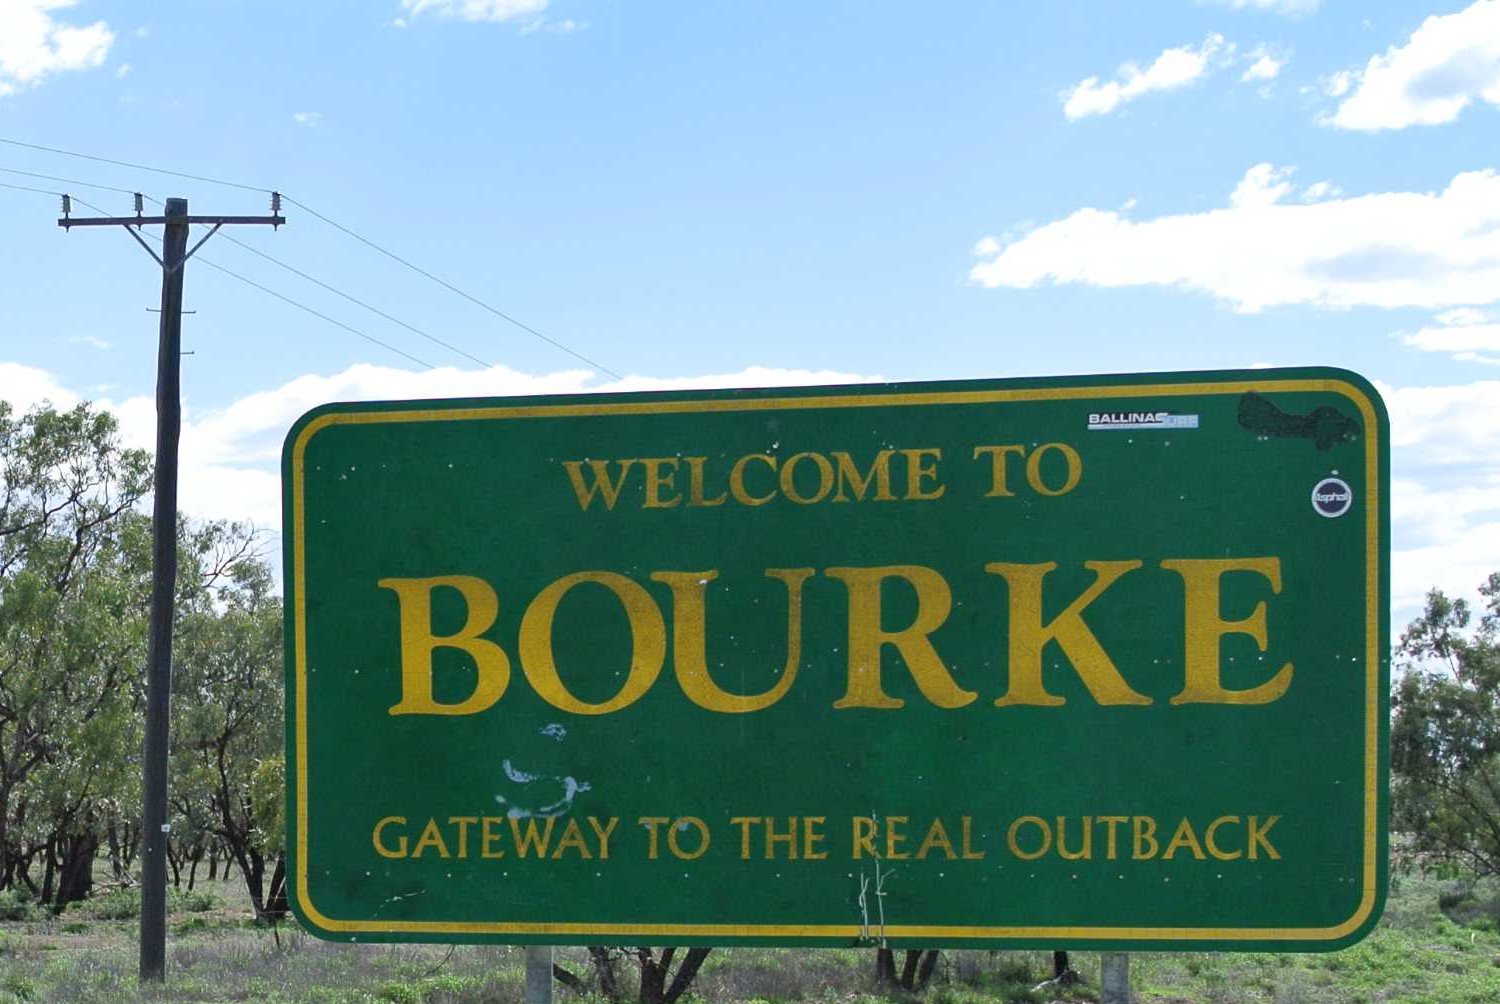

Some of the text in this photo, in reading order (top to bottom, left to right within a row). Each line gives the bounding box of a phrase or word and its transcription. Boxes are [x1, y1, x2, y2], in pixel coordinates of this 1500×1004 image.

[563, 442, 1083, 512] WELCOME TO
[378, 556, 1294, 717] BOURKE
[372, 815, 1283, 861] GATEWAY TO THE REAL OUTBACK
